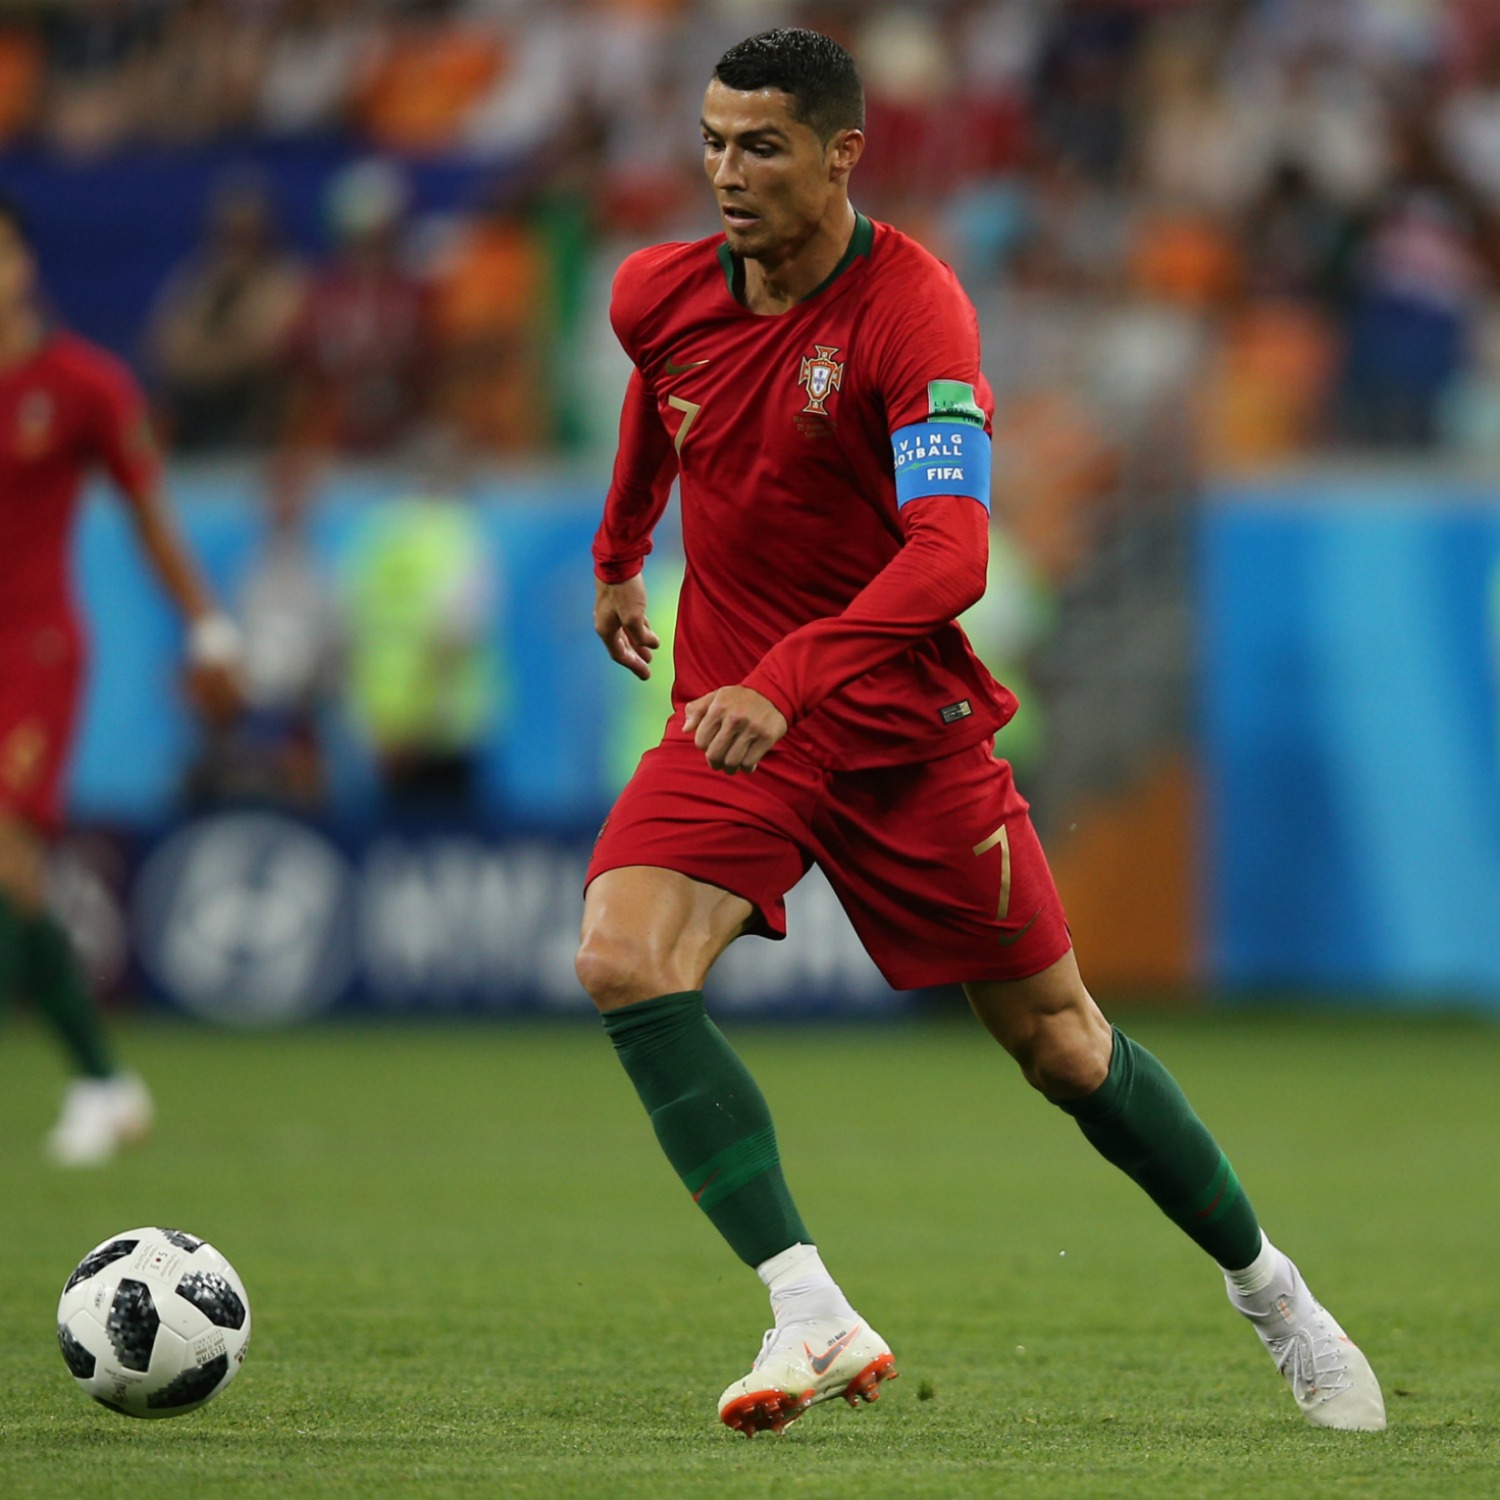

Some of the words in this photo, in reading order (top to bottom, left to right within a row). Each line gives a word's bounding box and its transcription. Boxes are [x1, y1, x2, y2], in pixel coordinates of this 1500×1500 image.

[668, 394, 701, 458] 7
[893, 434, 962, 457] IVING
[894, 445, 963, 469] OTBALL
[927, 468, 964, 480] FIFA
[973, 824, 1011, 921] 7
